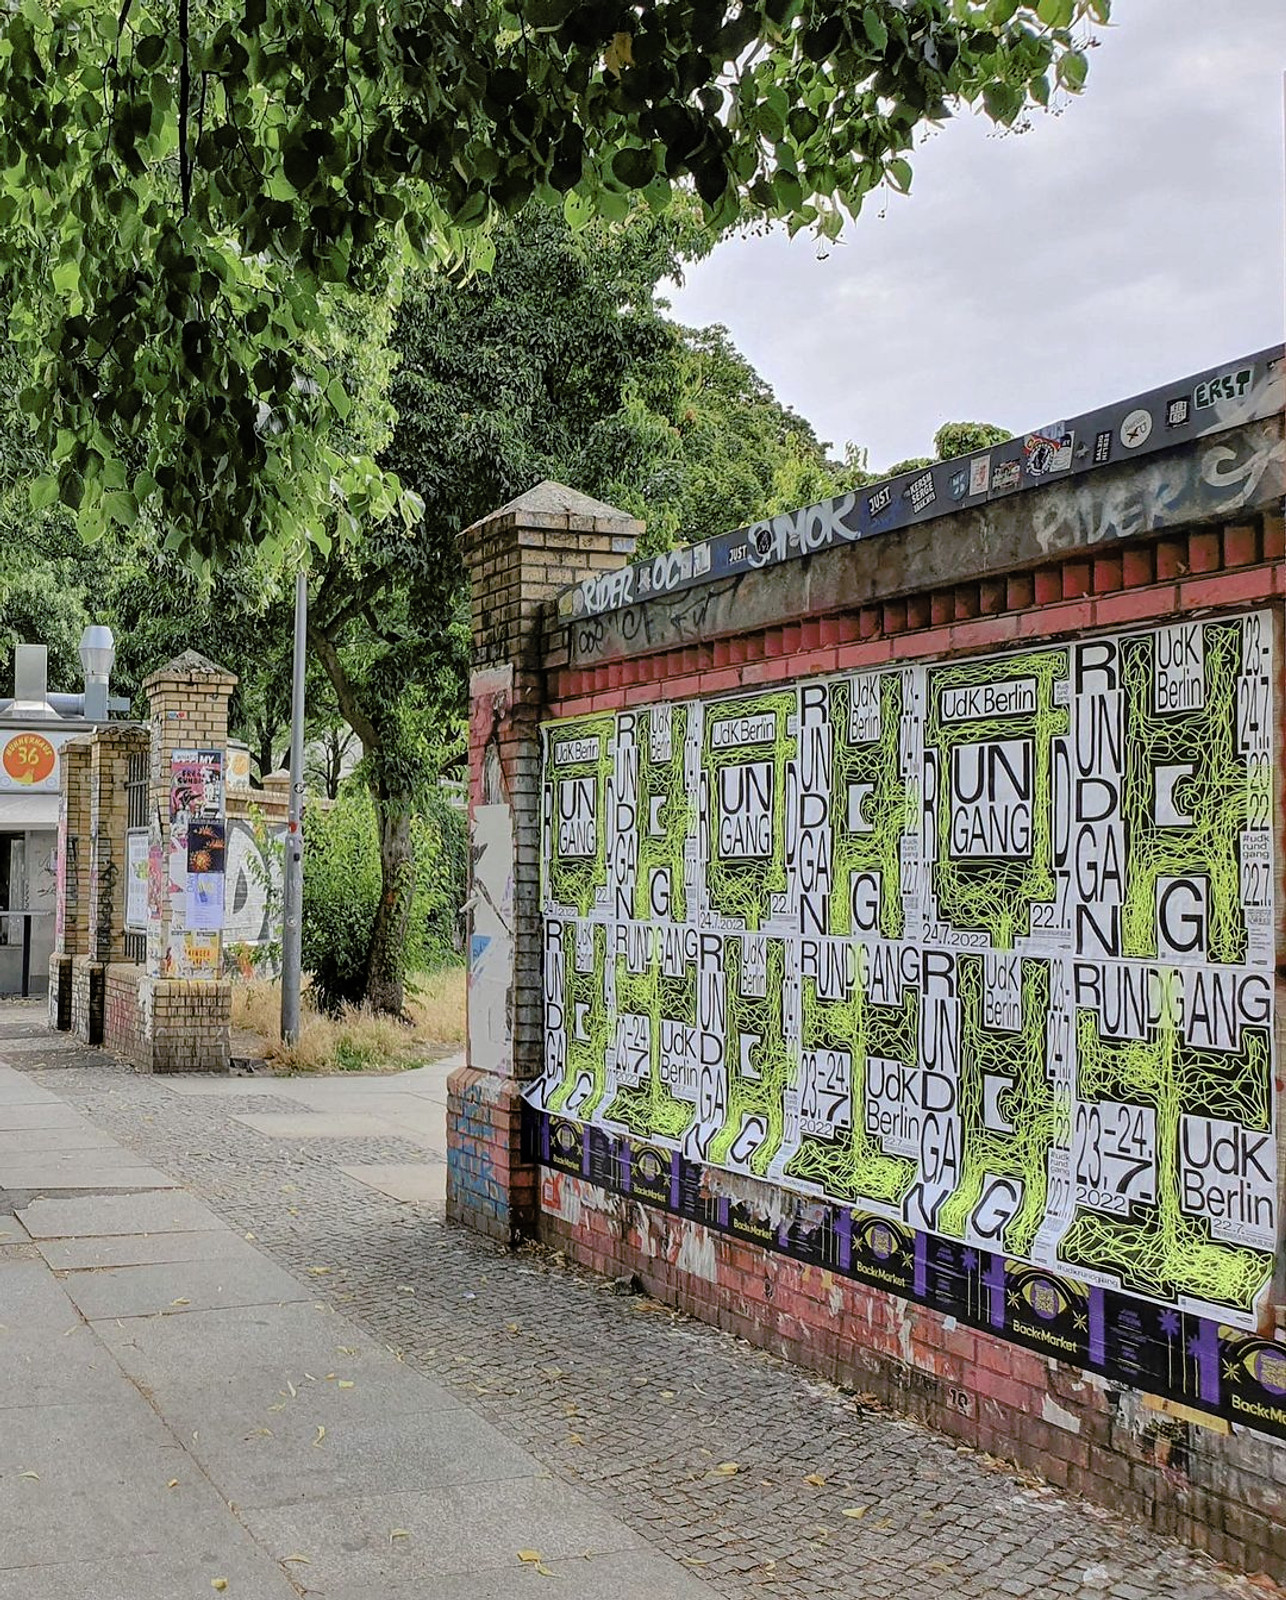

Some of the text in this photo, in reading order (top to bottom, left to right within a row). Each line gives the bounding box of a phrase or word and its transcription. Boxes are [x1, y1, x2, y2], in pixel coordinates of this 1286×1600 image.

[1194, 369, 1252, 410] ERST
[869, 486, 890, 513] JUST
[729, 544, 748, 562] JUST
[1159, 624, 1199, 670] UdK
[852, 677, 877, 708] UdK
[943, 691, 982, 718] UdK
[984, 685, 1034, 713] Berlin
[1159, 669, 1201, 709] Berlin
[18, 746, 39, 765] 36
[954, 742, 1030, 805] UN
[722, 766, 771, 814] UN
[721, 814, 770, 855] GANG
[953, 804, 1030, 854] GANG
[1242, 850, 1270, 860] gang
[853, 875, 878, 932] G
[1161, 880, 1204, 951] G
[801, 941, 920, 1002] RUNDGANG
[986, 957, 1019, 992] UdK
[986, 997, 1020, 1027] Berlin
[1073, 963, 1271, 1048] RUNDGANG
[662, 1021, 696, 1058] UdK
[661, 1054, 698, 1087] Berlin
[868, 1060, 918, 1106] UdK
[800, 1118, 832, 1136] 2022
[867, 1100, 919, 1140] Berlin
[1183, 1117, 1272, 1183] UdK
[972, 1180, 1016, 1239] G
[1076, 1187, 1126, 1213] 2022
[1183, 1168, 1273, 1229] Berlin
[1213, 1218, 1245, 1234] 22.7.
